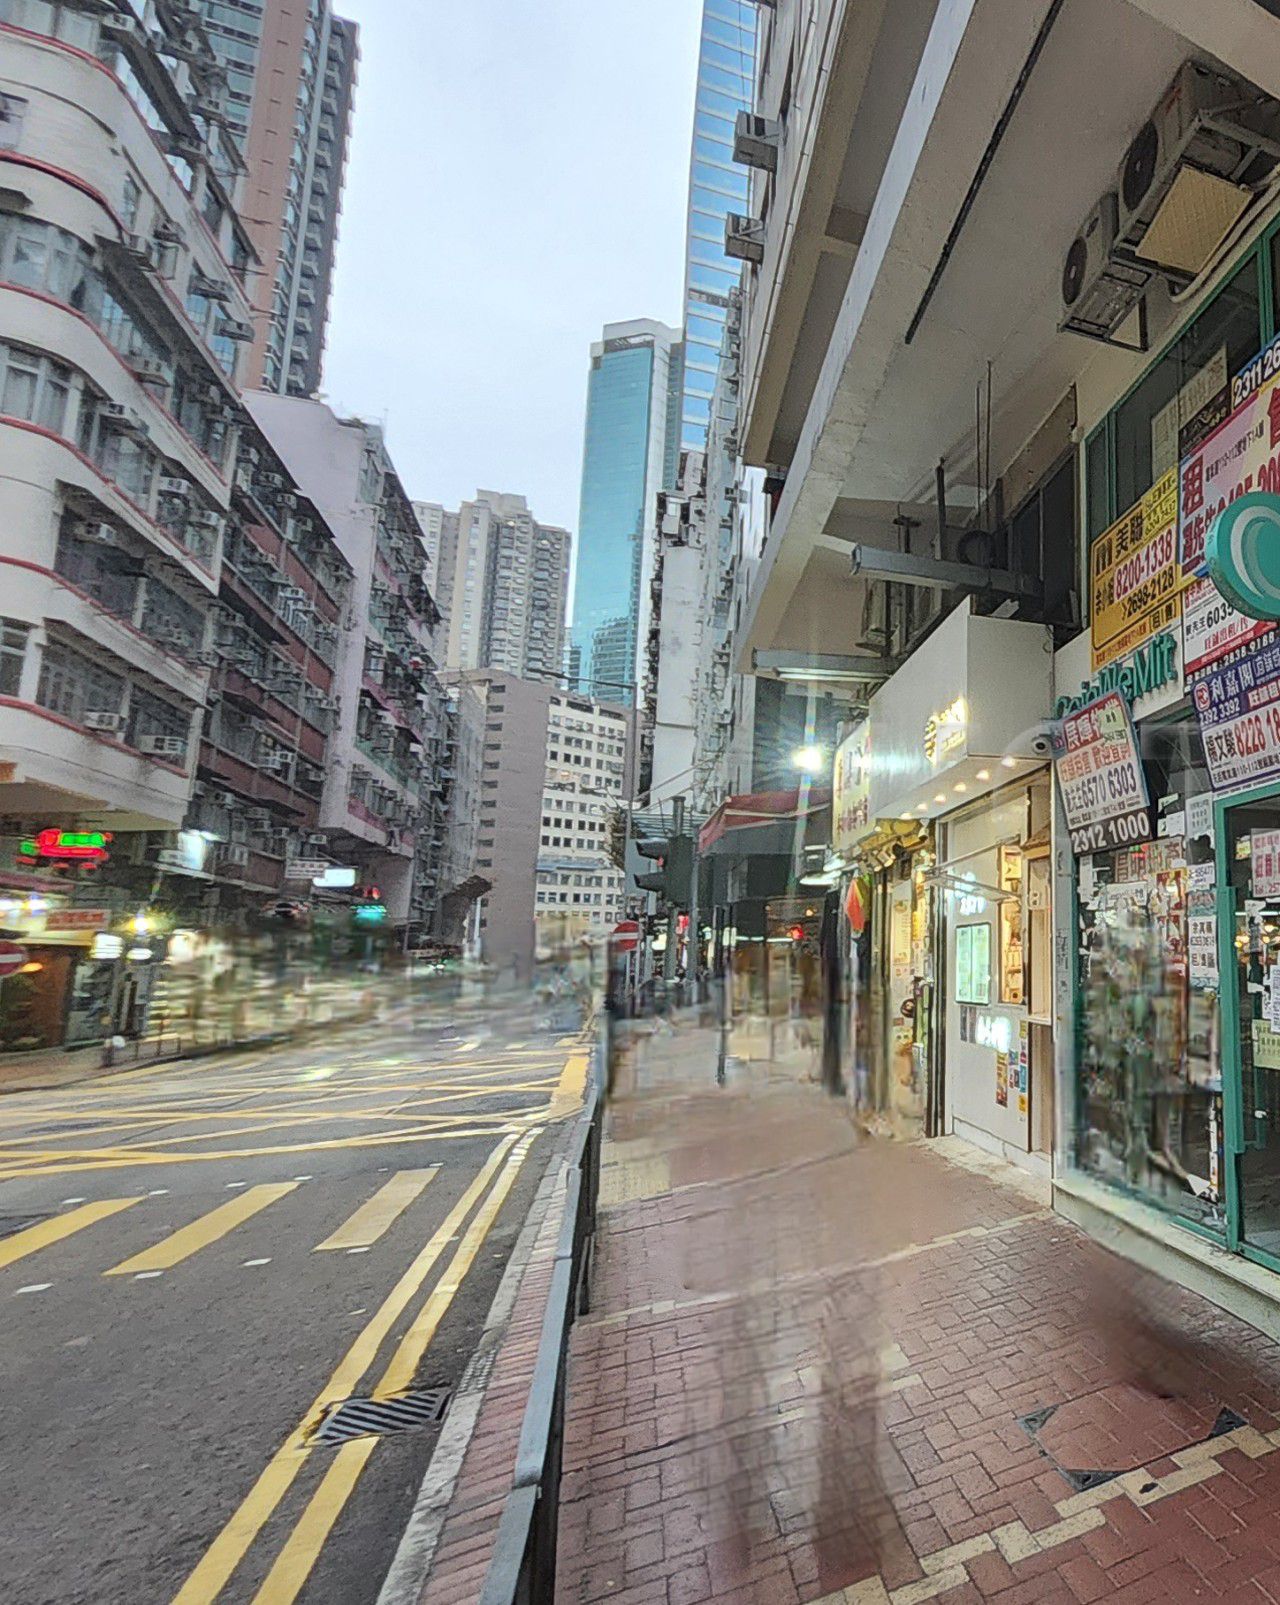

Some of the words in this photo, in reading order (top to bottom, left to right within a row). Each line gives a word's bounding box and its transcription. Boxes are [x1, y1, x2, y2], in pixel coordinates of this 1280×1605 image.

[1233, 364, 1261, 408] 2311
[1234, 710, 1267, 759] 8228
[1107, 762, 1138, 800] 6303
[1071, 824, 1107, 854] 2312
[1108, 811, 1151, 844] 1000
